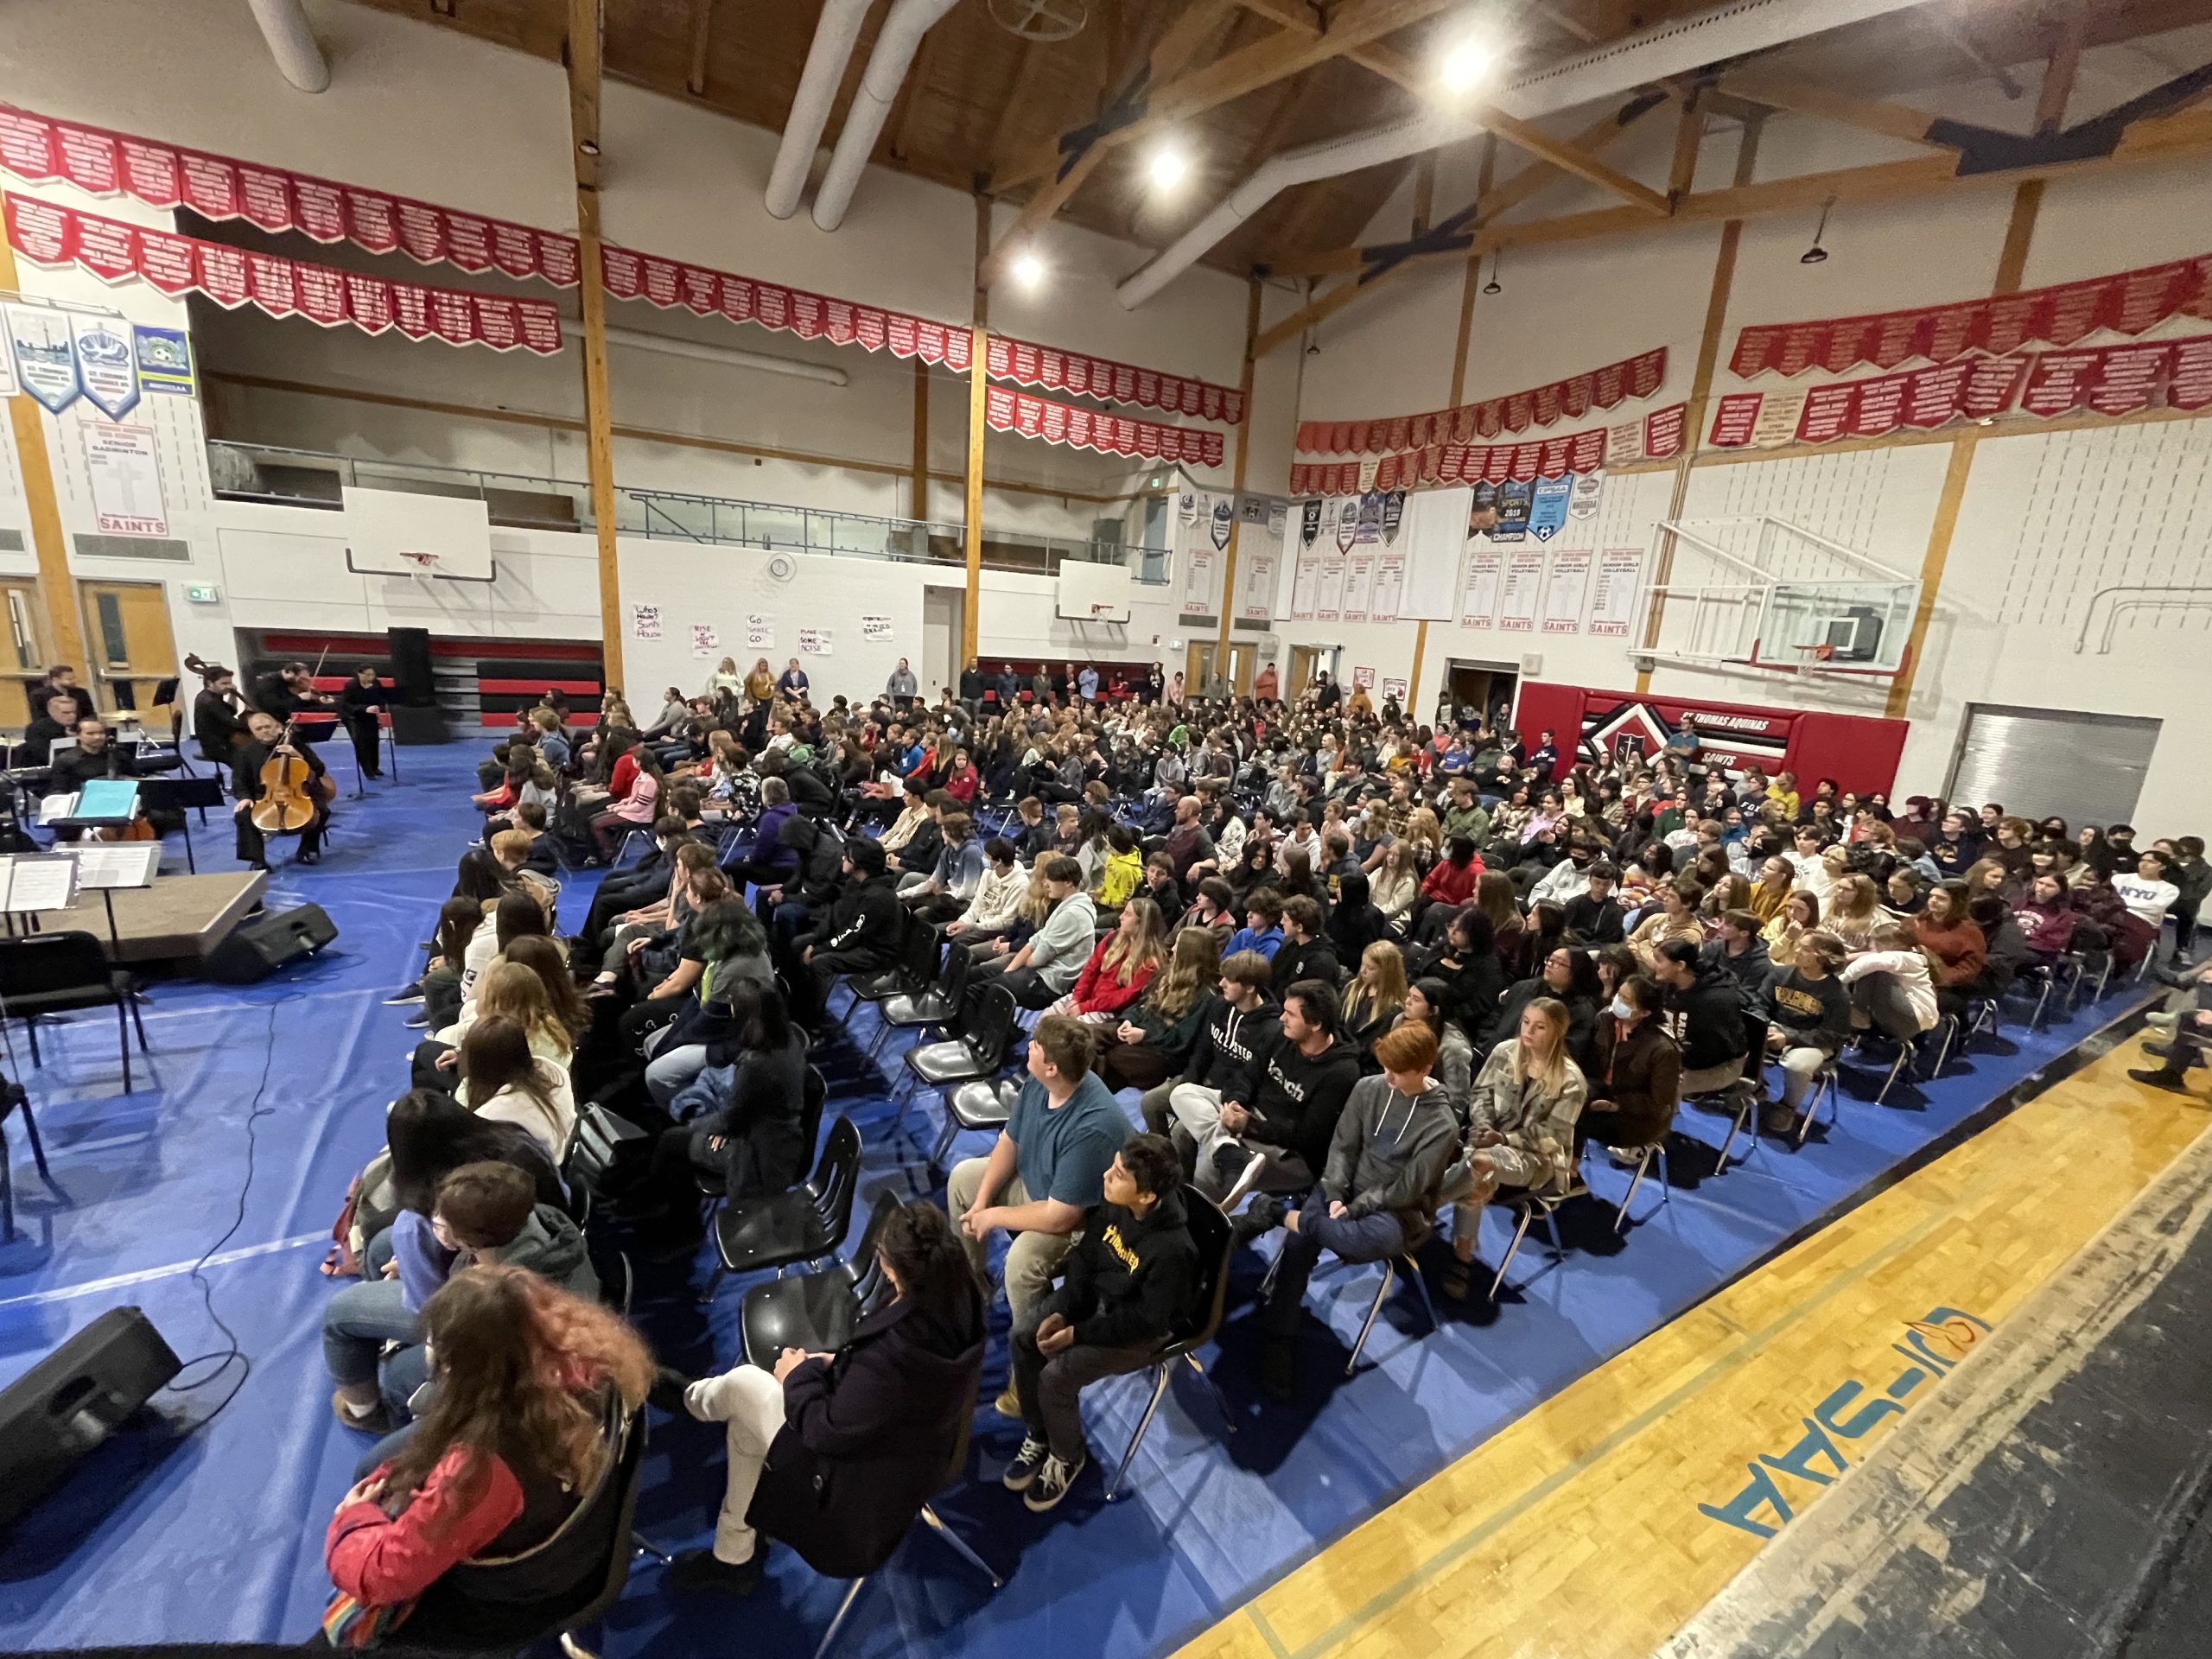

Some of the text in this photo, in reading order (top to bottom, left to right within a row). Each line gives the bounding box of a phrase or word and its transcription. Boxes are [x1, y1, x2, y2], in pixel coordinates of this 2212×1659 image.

[99, 518, 166, 534] SAINTS
[1461, 618, 1491, 627] SAINTS
[1500, 620, 1533, 630] SAINTS
[1543, 622, 1579, 632] SAINTS
[1591, 624, 1628, 634] SAINTS
[1694, 712, 1731, 727] THOMAS
[1726, 717, 1770, 731] AQUINAS
[1700, 752, 1738, 766] SAINTS
[2120, 886, 2158, 901] NYU
[1211, 1022, 1253, 1062] HOLLSTER
[1267, 1057, 1305, 1103] Bech
